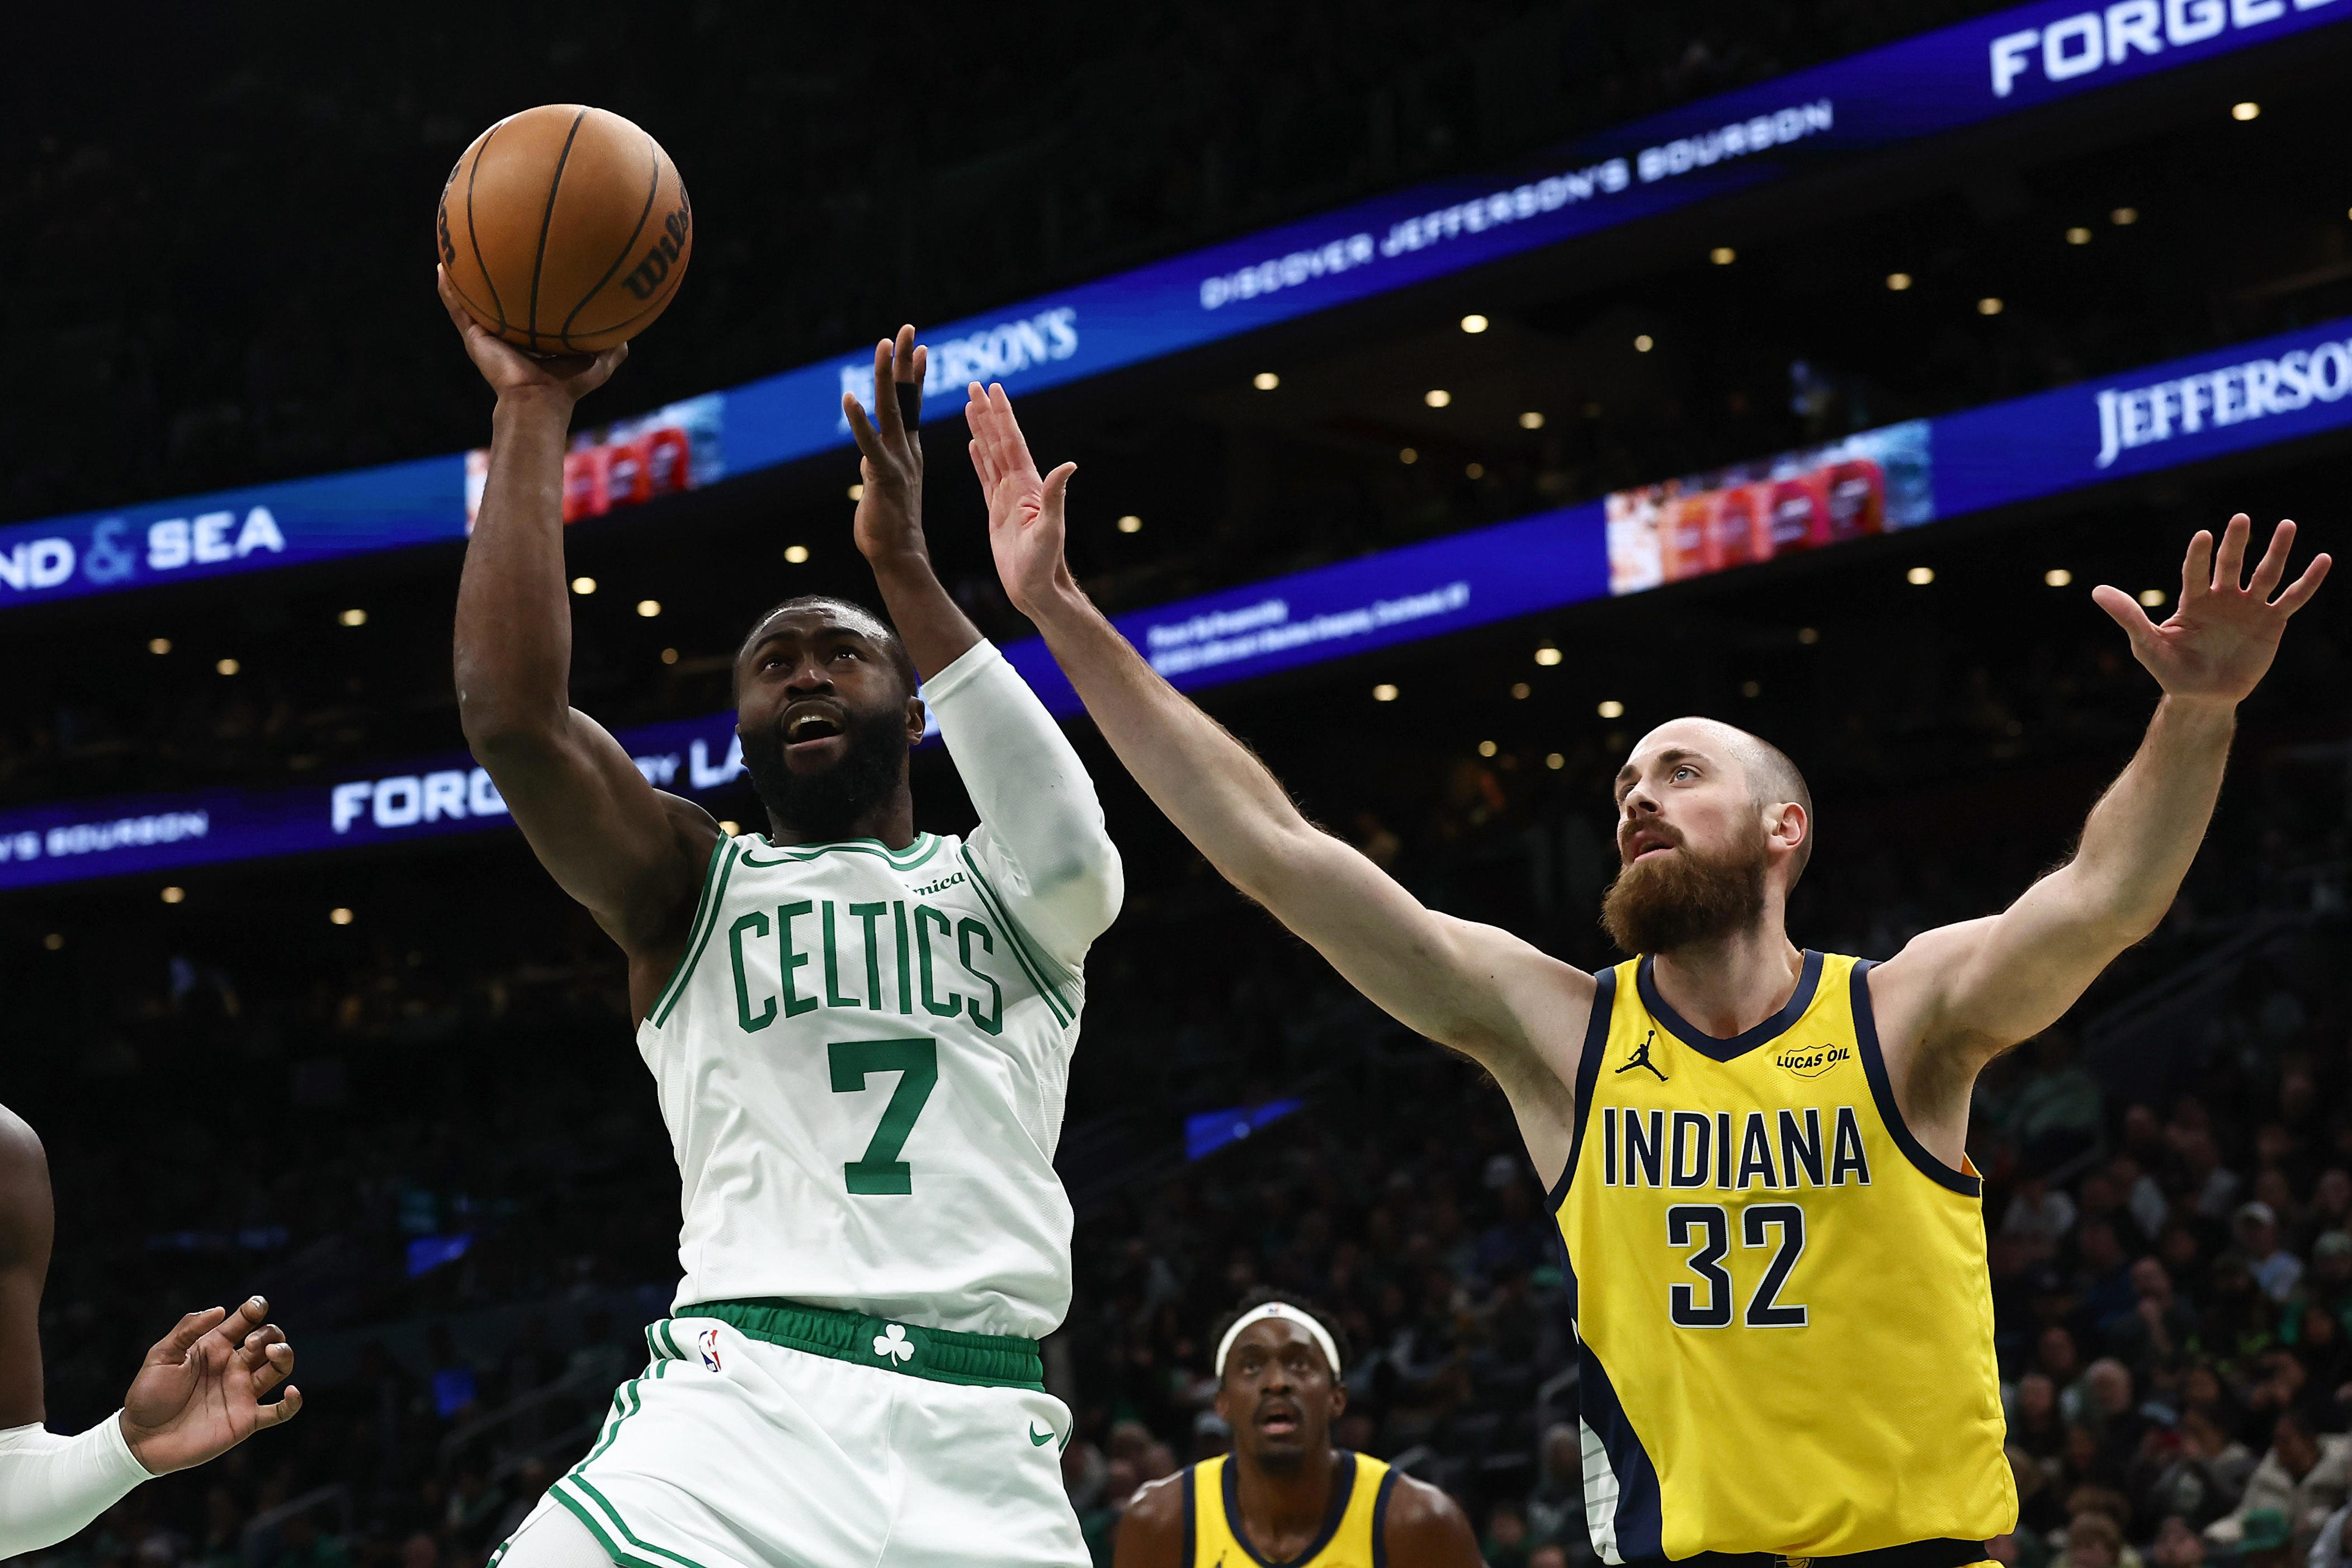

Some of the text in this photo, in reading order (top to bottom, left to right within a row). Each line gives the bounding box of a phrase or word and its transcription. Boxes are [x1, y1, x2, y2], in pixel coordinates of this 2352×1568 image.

[1200, 97, 1833, 310] DISCOVER JEFFERSON'S BOURBON
[2095, 338, 2352, 469] JEFFERSO
[83, 516, 136, 584] &
[147, 505, 286, 570] SEA
[45, 810, 209, 857] BOURBON
[904, 872, 965, 895] mica
[729, 900, 1003, 1036] CELTICS
[1777, 1048, 1850, 1069] LUCAS OIL
[828, 1038, 938, 1195] 7
[1603, 1106, 1872, 1192] INDIANA
[1665, 1202, 1808, 1329] 32
